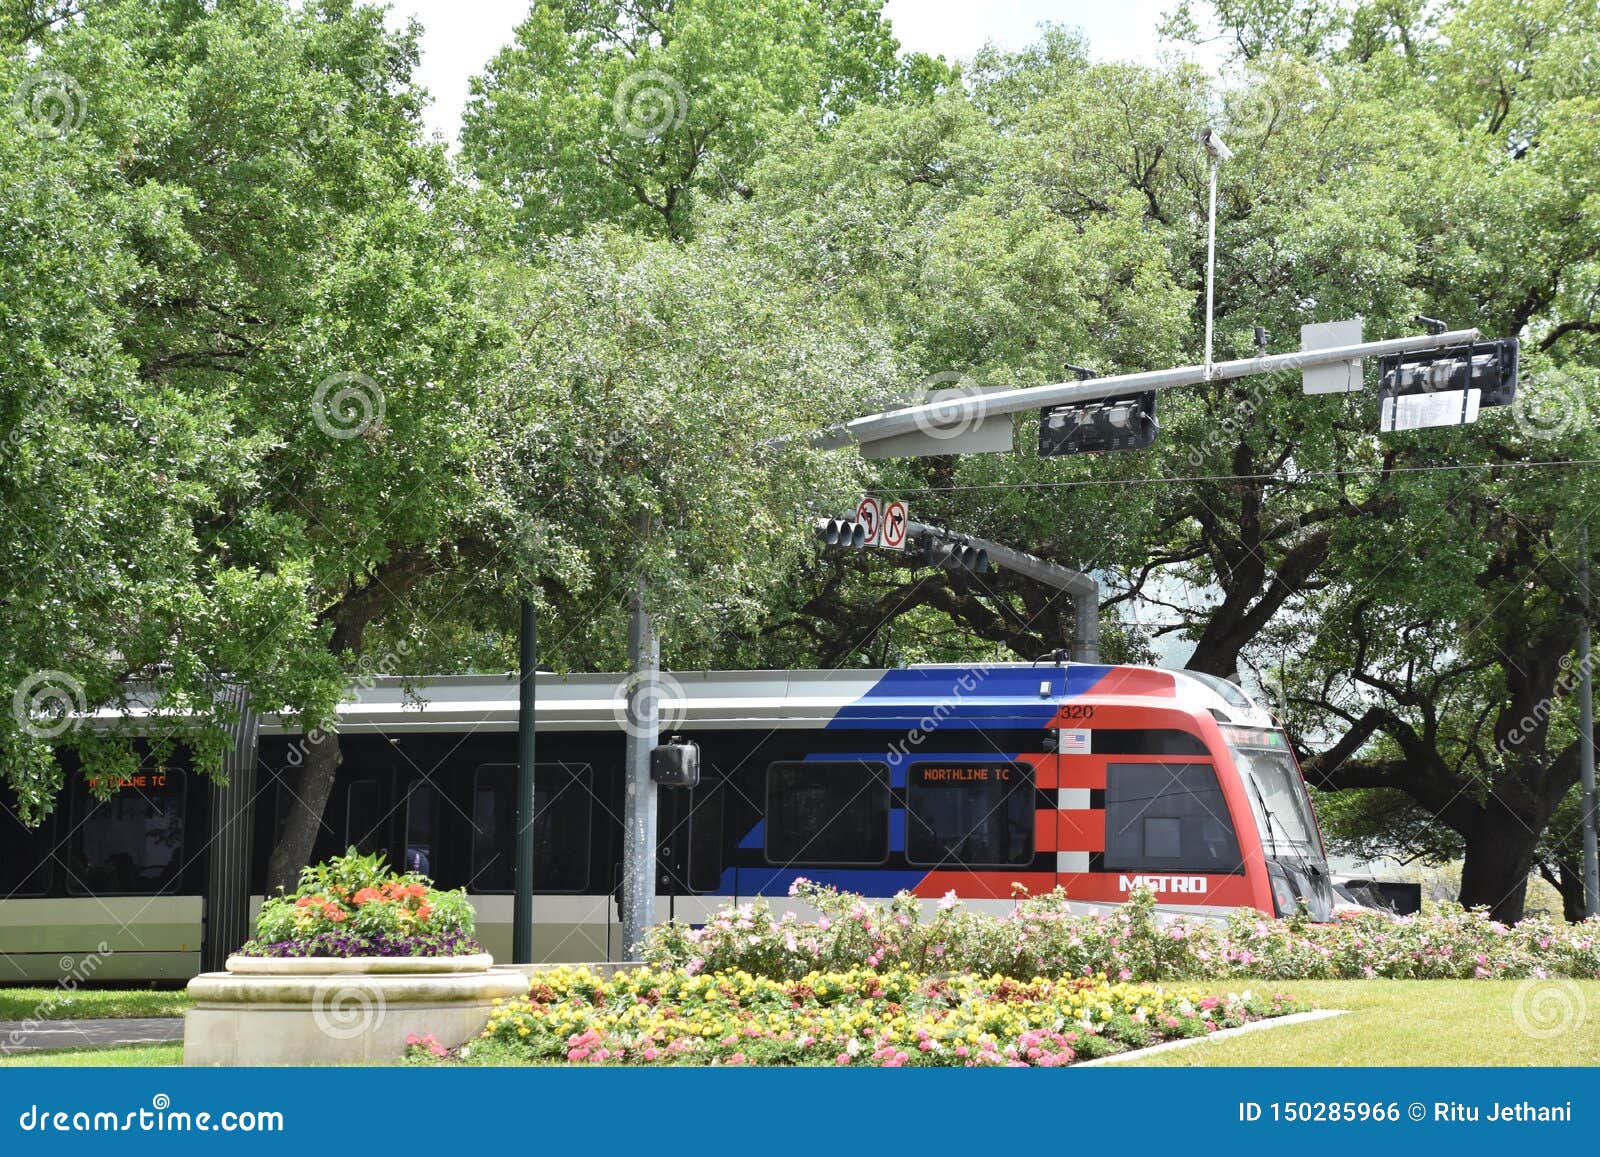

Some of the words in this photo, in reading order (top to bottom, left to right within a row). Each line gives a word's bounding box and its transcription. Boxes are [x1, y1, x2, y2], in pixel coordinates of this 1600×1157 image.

[1060, 705, 1094, 719] 320
[924, 769, 988, 780] NORTHLINE
[995, 769, 1009, 780] TC
[151, 776, 166, 786] TC
